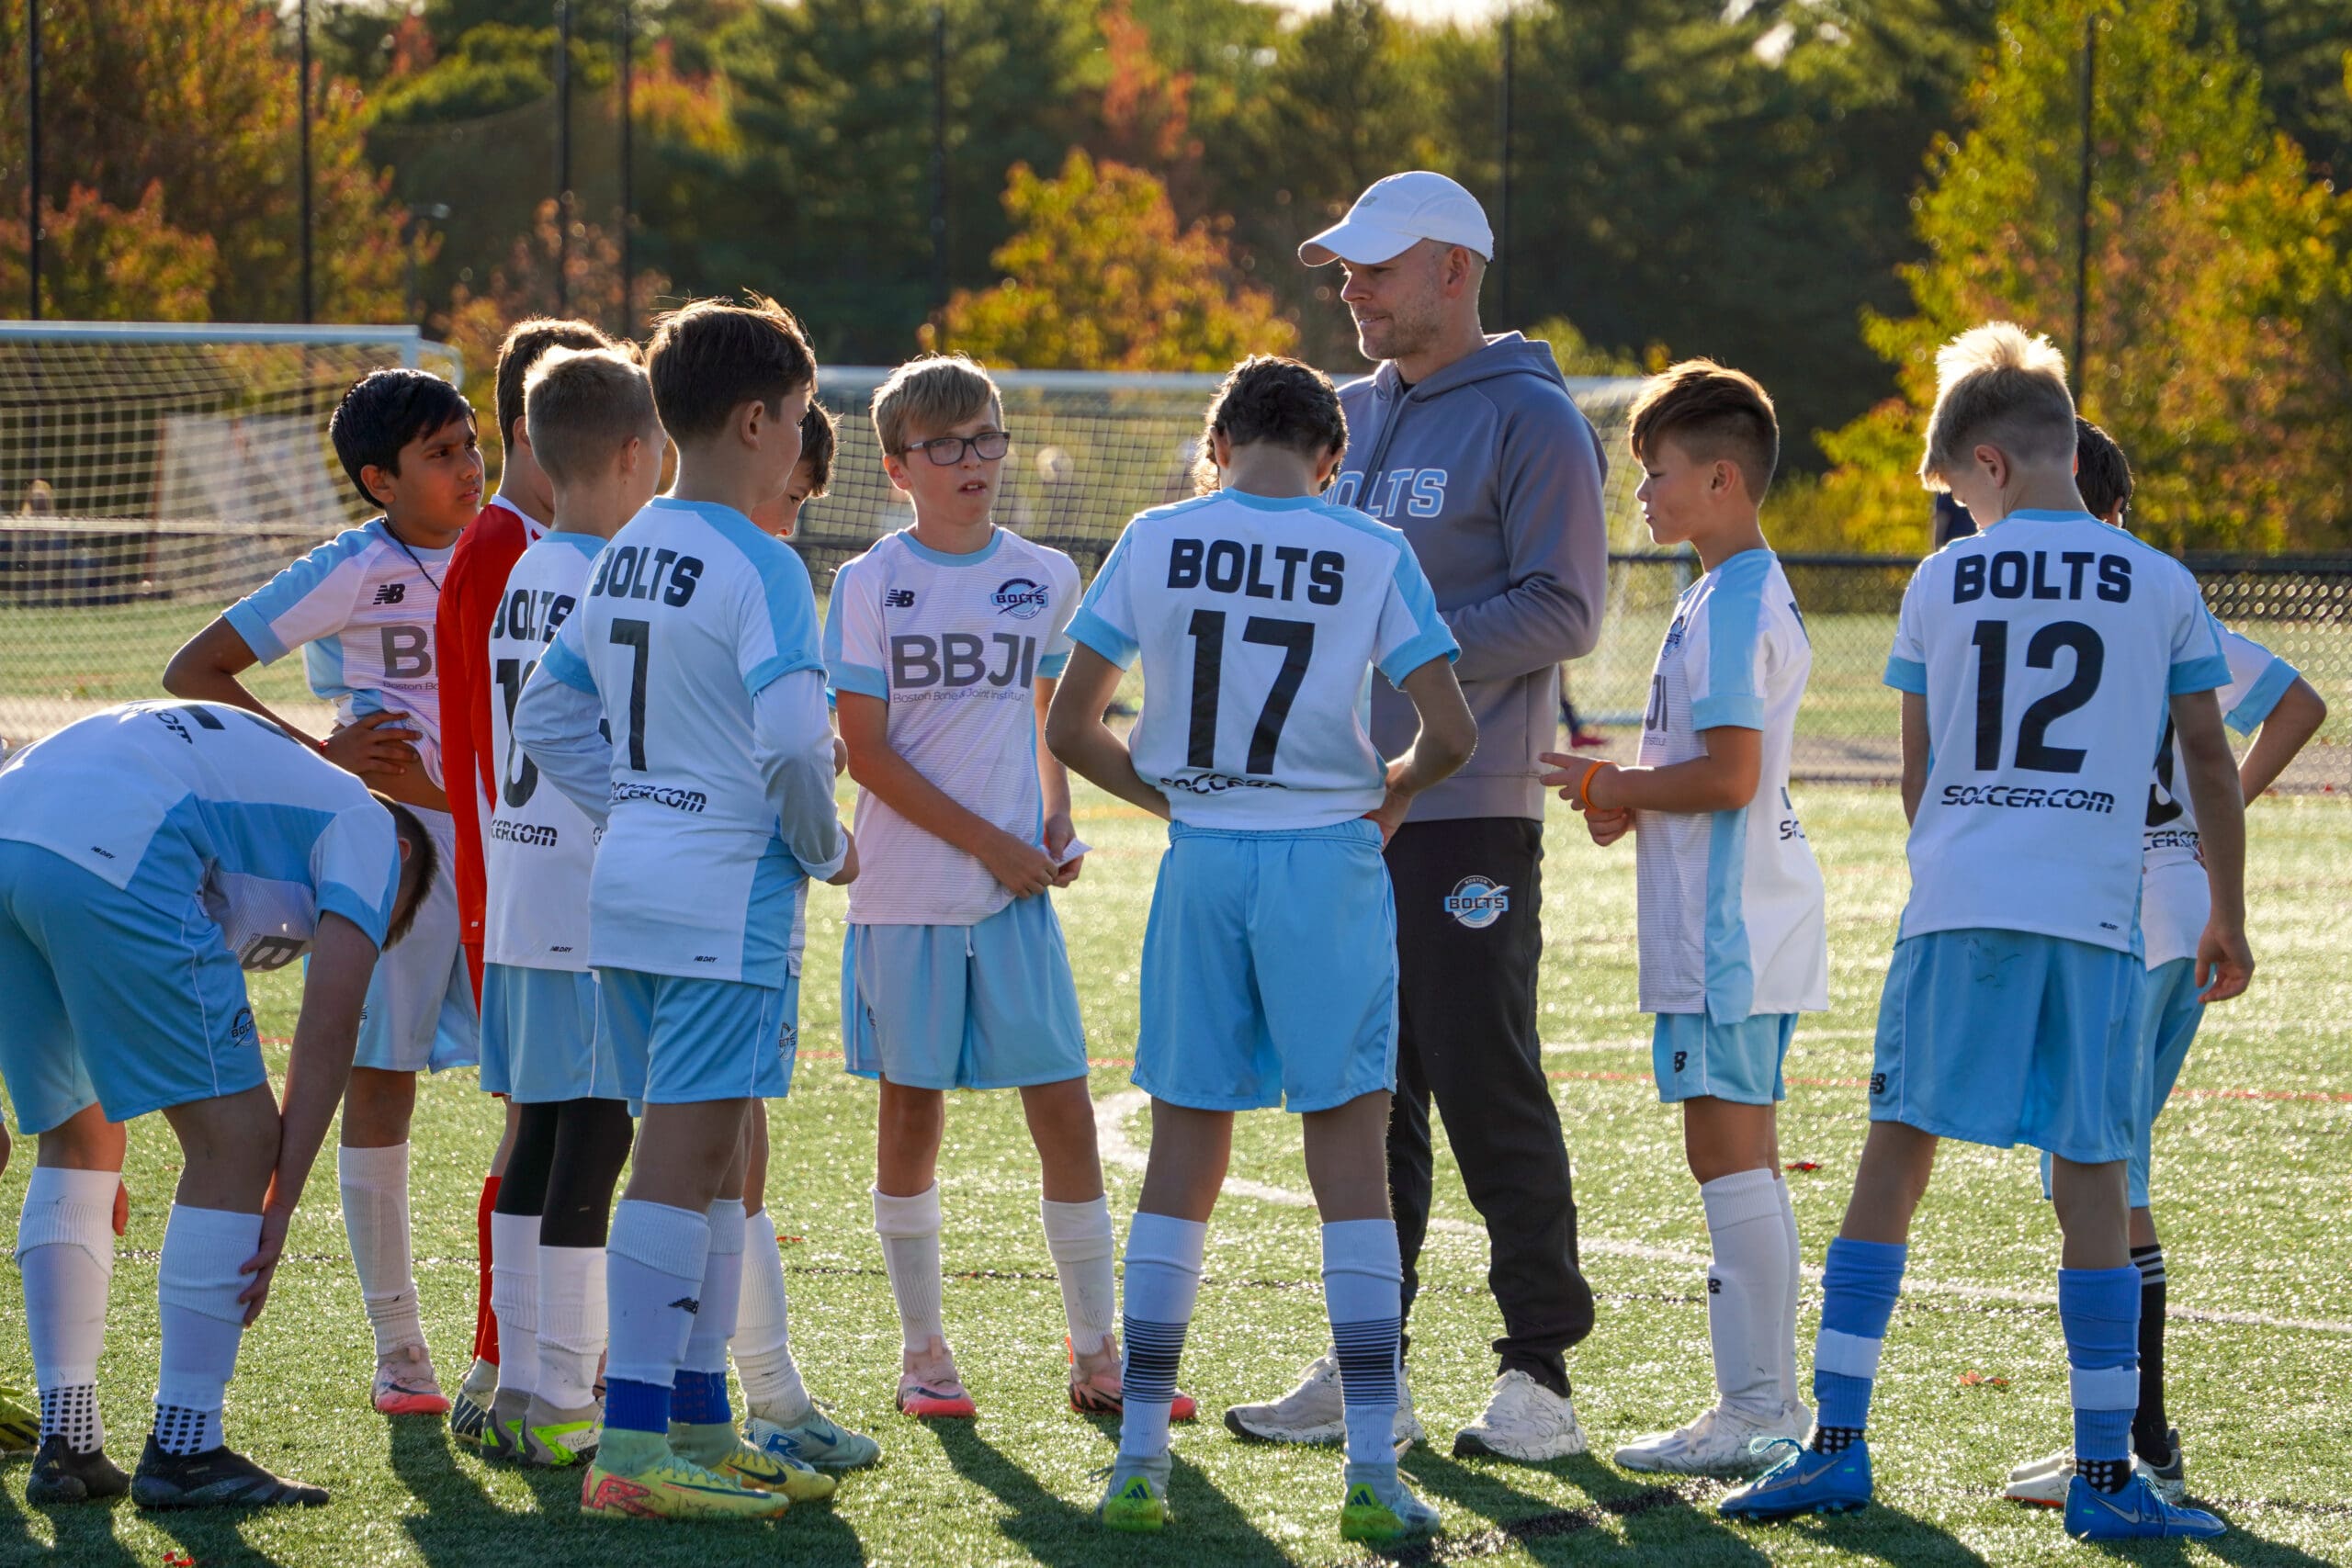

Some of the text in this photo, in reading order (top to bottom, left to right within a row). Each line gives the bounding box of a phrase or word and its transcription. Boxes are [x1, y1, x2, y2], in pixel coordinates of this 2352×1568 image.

[1323, 468, 1448, 519] OLTS
[996, 592, 1045, 604] BOLTS
[1167, 537, 1345, 606] BOLTS
[1953, 550, 2132, 604] BOLTS
[890, 632, 1036, 689] BBJI
[610, 617, 650, 773] 7
[893, 692, 932, 704] Boston
[1187, 609, 1315, 775] 17
[1972, 619, 2105, 774] 12
[1941, 784, 2115, 814] SOCCER.COM
[1450, 897, 1505, 909] BOLTS
